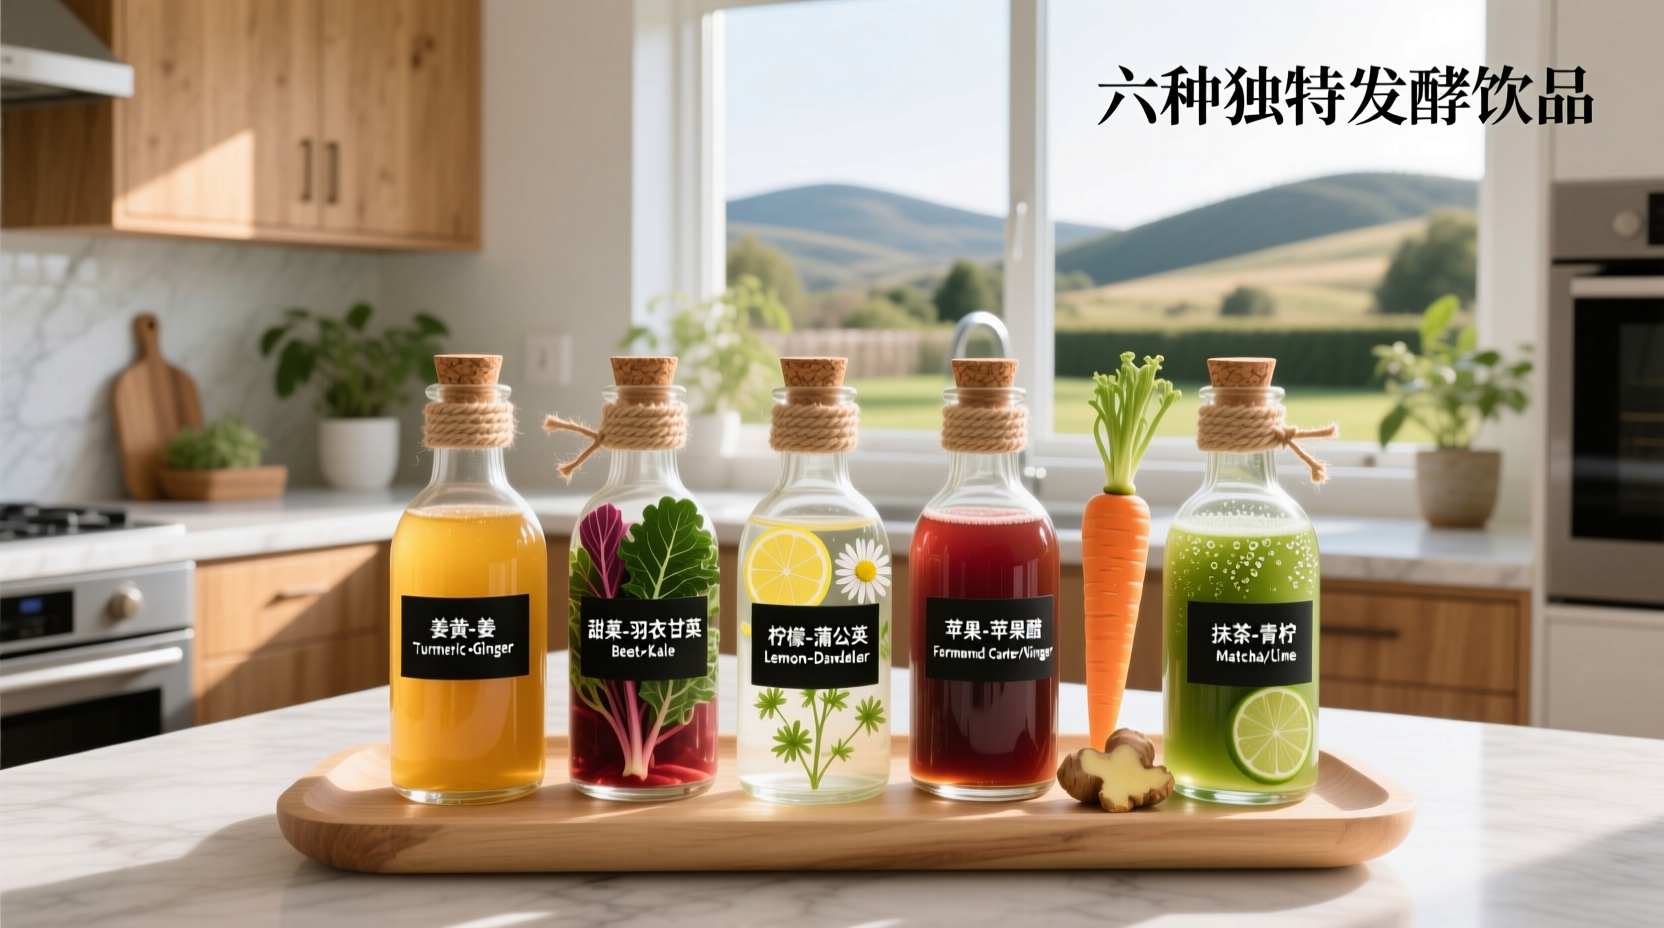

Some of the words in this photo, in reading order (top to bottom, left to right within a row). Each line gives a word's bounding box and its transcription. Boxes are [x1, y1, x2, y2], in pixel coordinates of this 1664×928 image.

[430, 616, 496, 639] 姜黄-姜
[767, 624, 869, 648] 柠檬-蒲公英
[1211, 622, 1297, 645] 抹茶-青柠
[1216, 648, 1297, 665] Matcha/Lime
